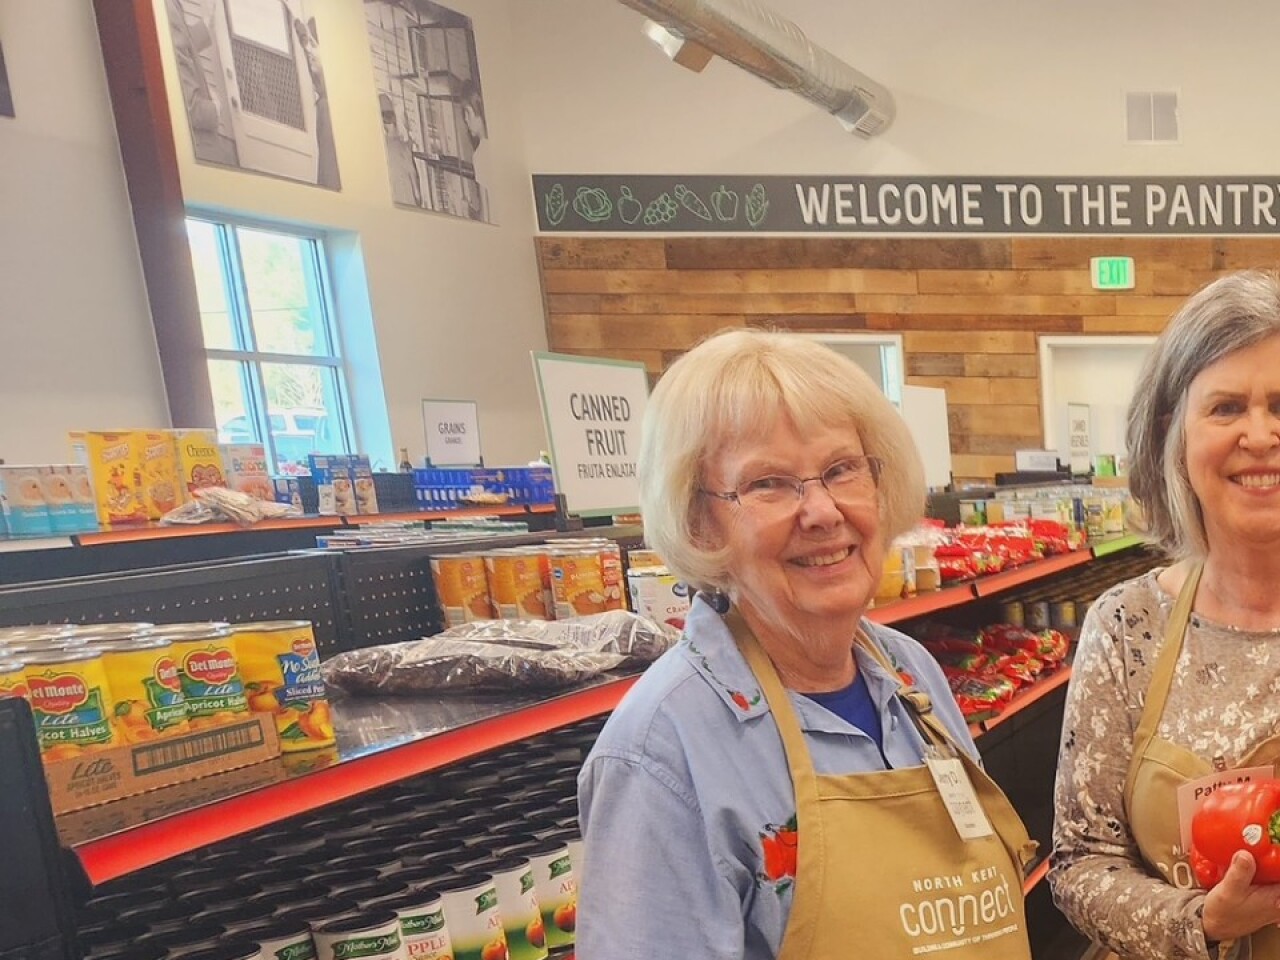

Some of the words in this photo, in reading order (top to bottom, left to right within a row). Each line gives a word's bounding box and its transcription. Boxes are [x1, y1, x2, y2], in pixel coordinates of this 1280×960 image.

[795, 183, 984, 225] WELCOME
[996, 184, 1043, 225] TO
[1055, 184, 1132, 226] THE
[1099, 258, 1129, 286] EXIT
[570, 392, 631, 422] CANNED
[438, 422, 466, 434] GRAINS
[585, 429, 628, 456] FRUIT
[577, 463, 605, 479] FRUTA
[606, 463, 637, 478] ENLATA
[190, 661, 208, 672] Del
[282, 659, 300, 674] No
[45, 684, 84, 698] Monte
[285, 686, 312, 697] Sliced
[184, 699, 225, 713] Apricot
[41, 713, 80, 726] Lite
[70, 725, 106, 739] Halves
[71, 757, 113, 780] Lite
[1194, 781, 1232, 800] Patt
[912, 875, 962, 893] NORTH
[971, 866, 998, 884] KENT
[899, 874, 1015, 937] connect
[407, 936, 446, 956] PPLE
